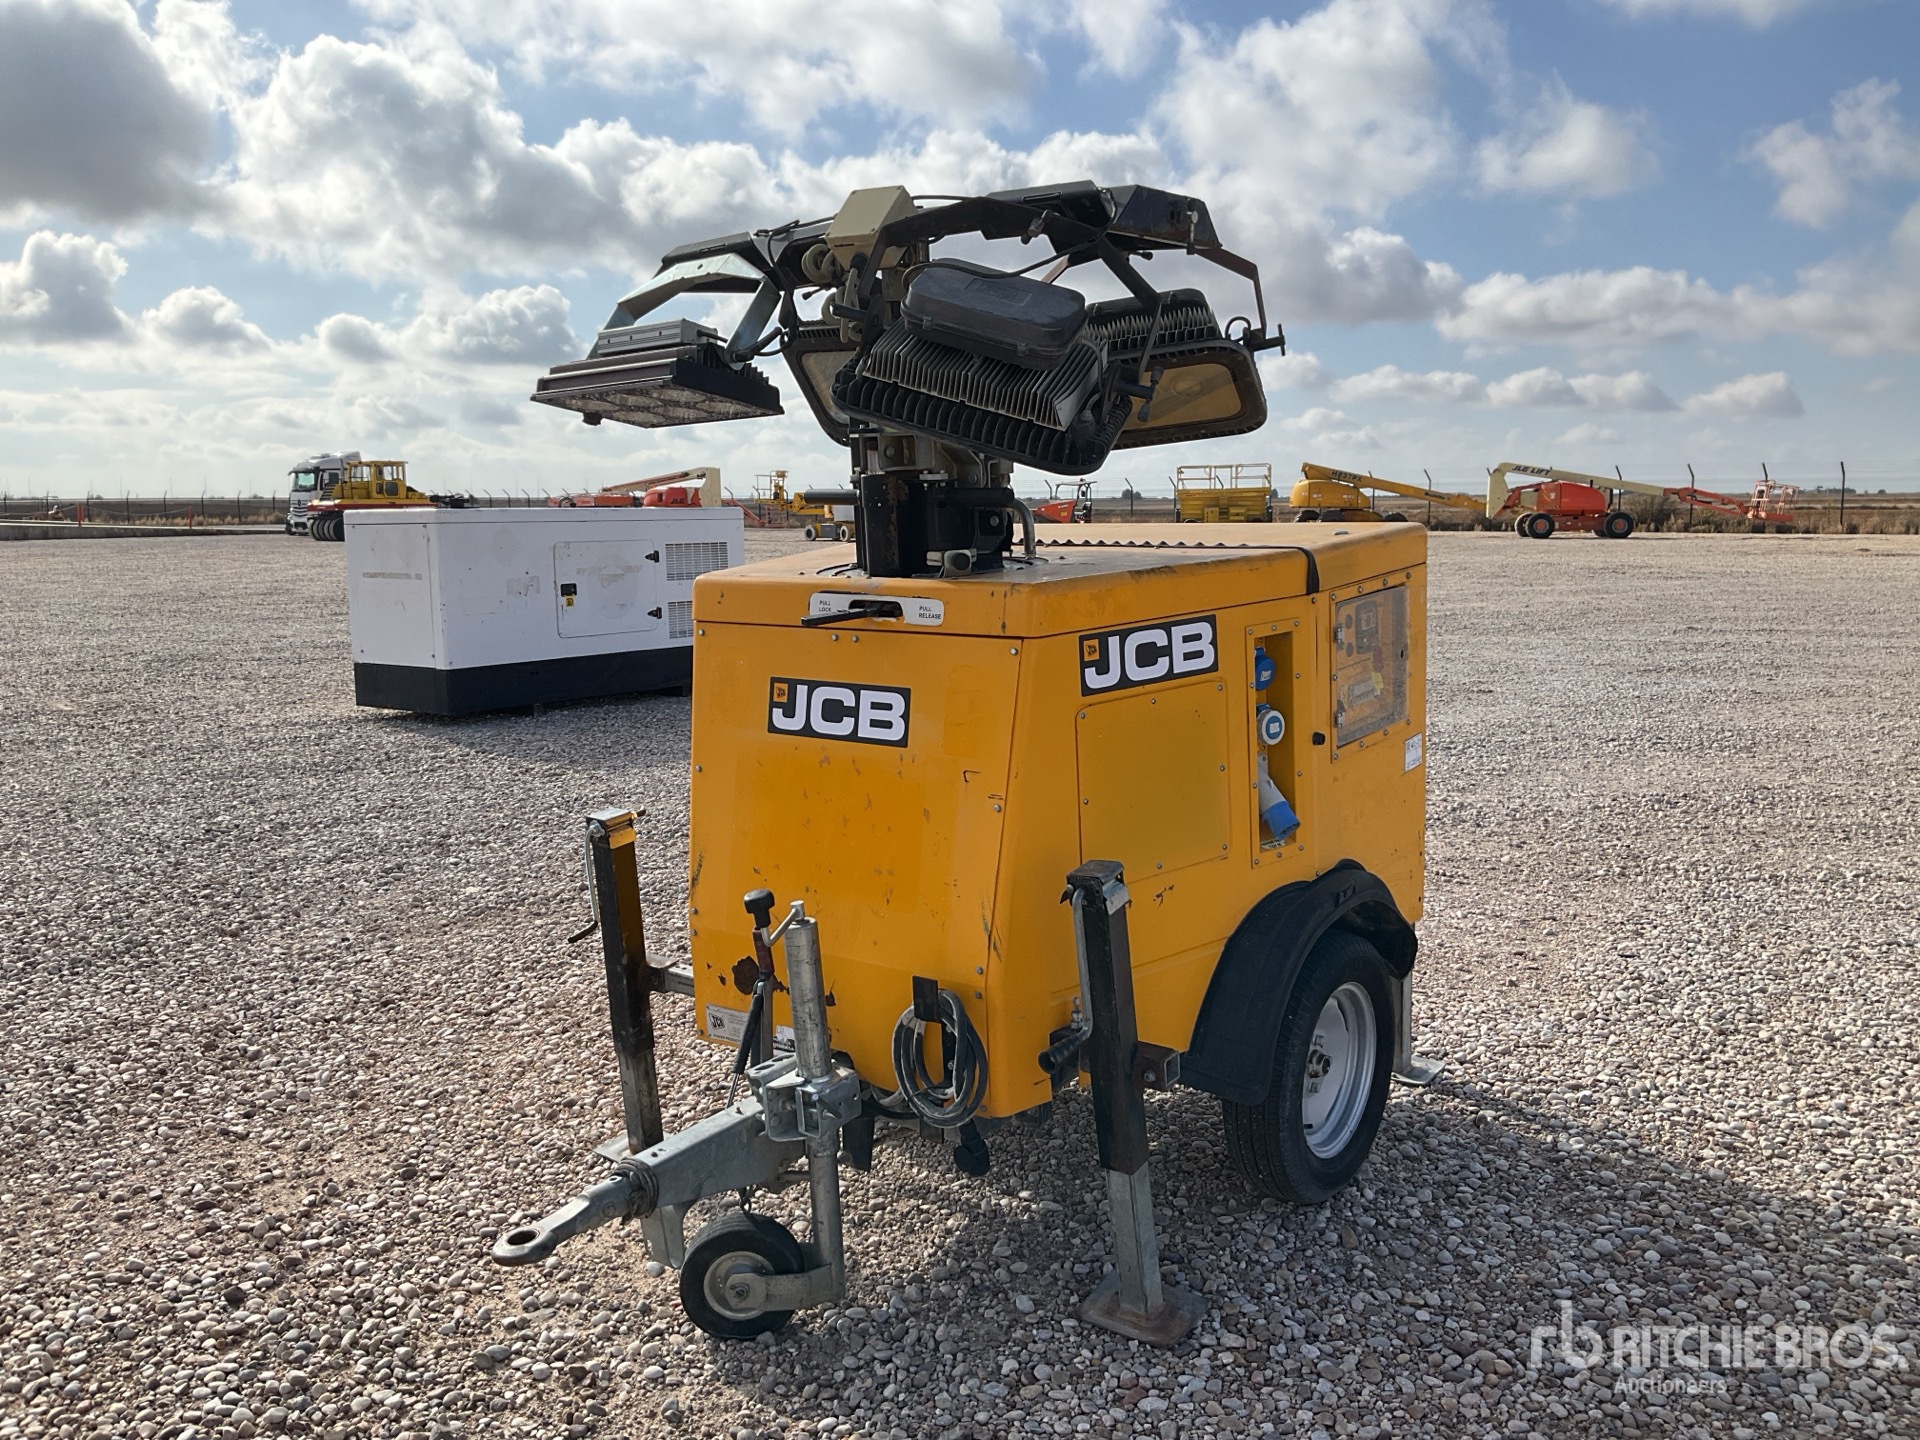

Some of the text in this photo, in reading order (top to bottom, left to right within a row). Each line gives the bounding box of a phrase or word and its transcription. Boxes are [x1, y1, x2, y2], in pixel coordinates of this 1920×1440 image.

[1530, 467, 1550, 475] LIFT
[1085, 621, 1214, 689] JCB
[772, 684, 906, 741] JCB
